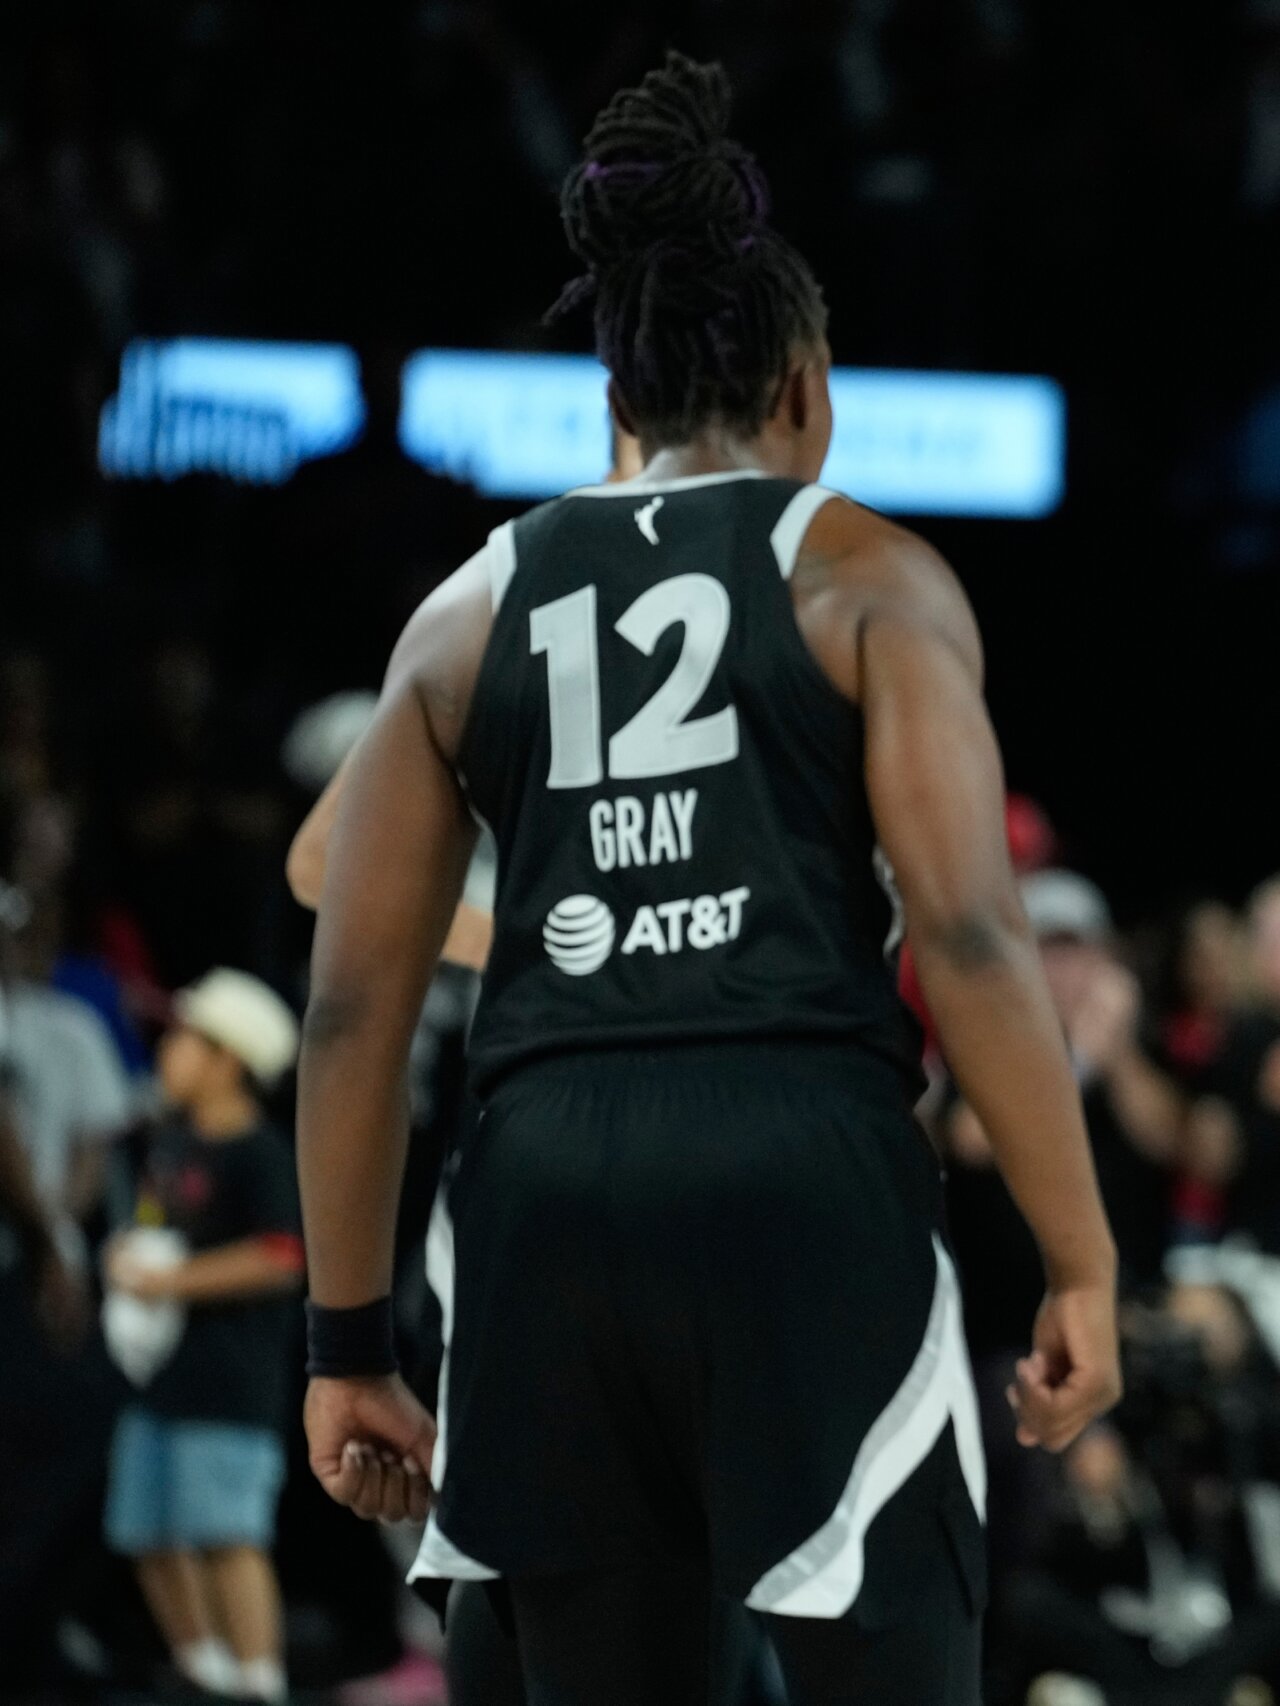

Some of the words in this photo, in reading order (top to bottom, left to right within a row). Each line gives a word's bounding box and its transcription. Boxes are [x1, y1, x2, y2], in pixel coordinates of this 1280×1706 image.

[529, 572, 739, 789] 12
[589, 788, 698, 872] GRAY
[620, 886, 750, 955] AT&T
